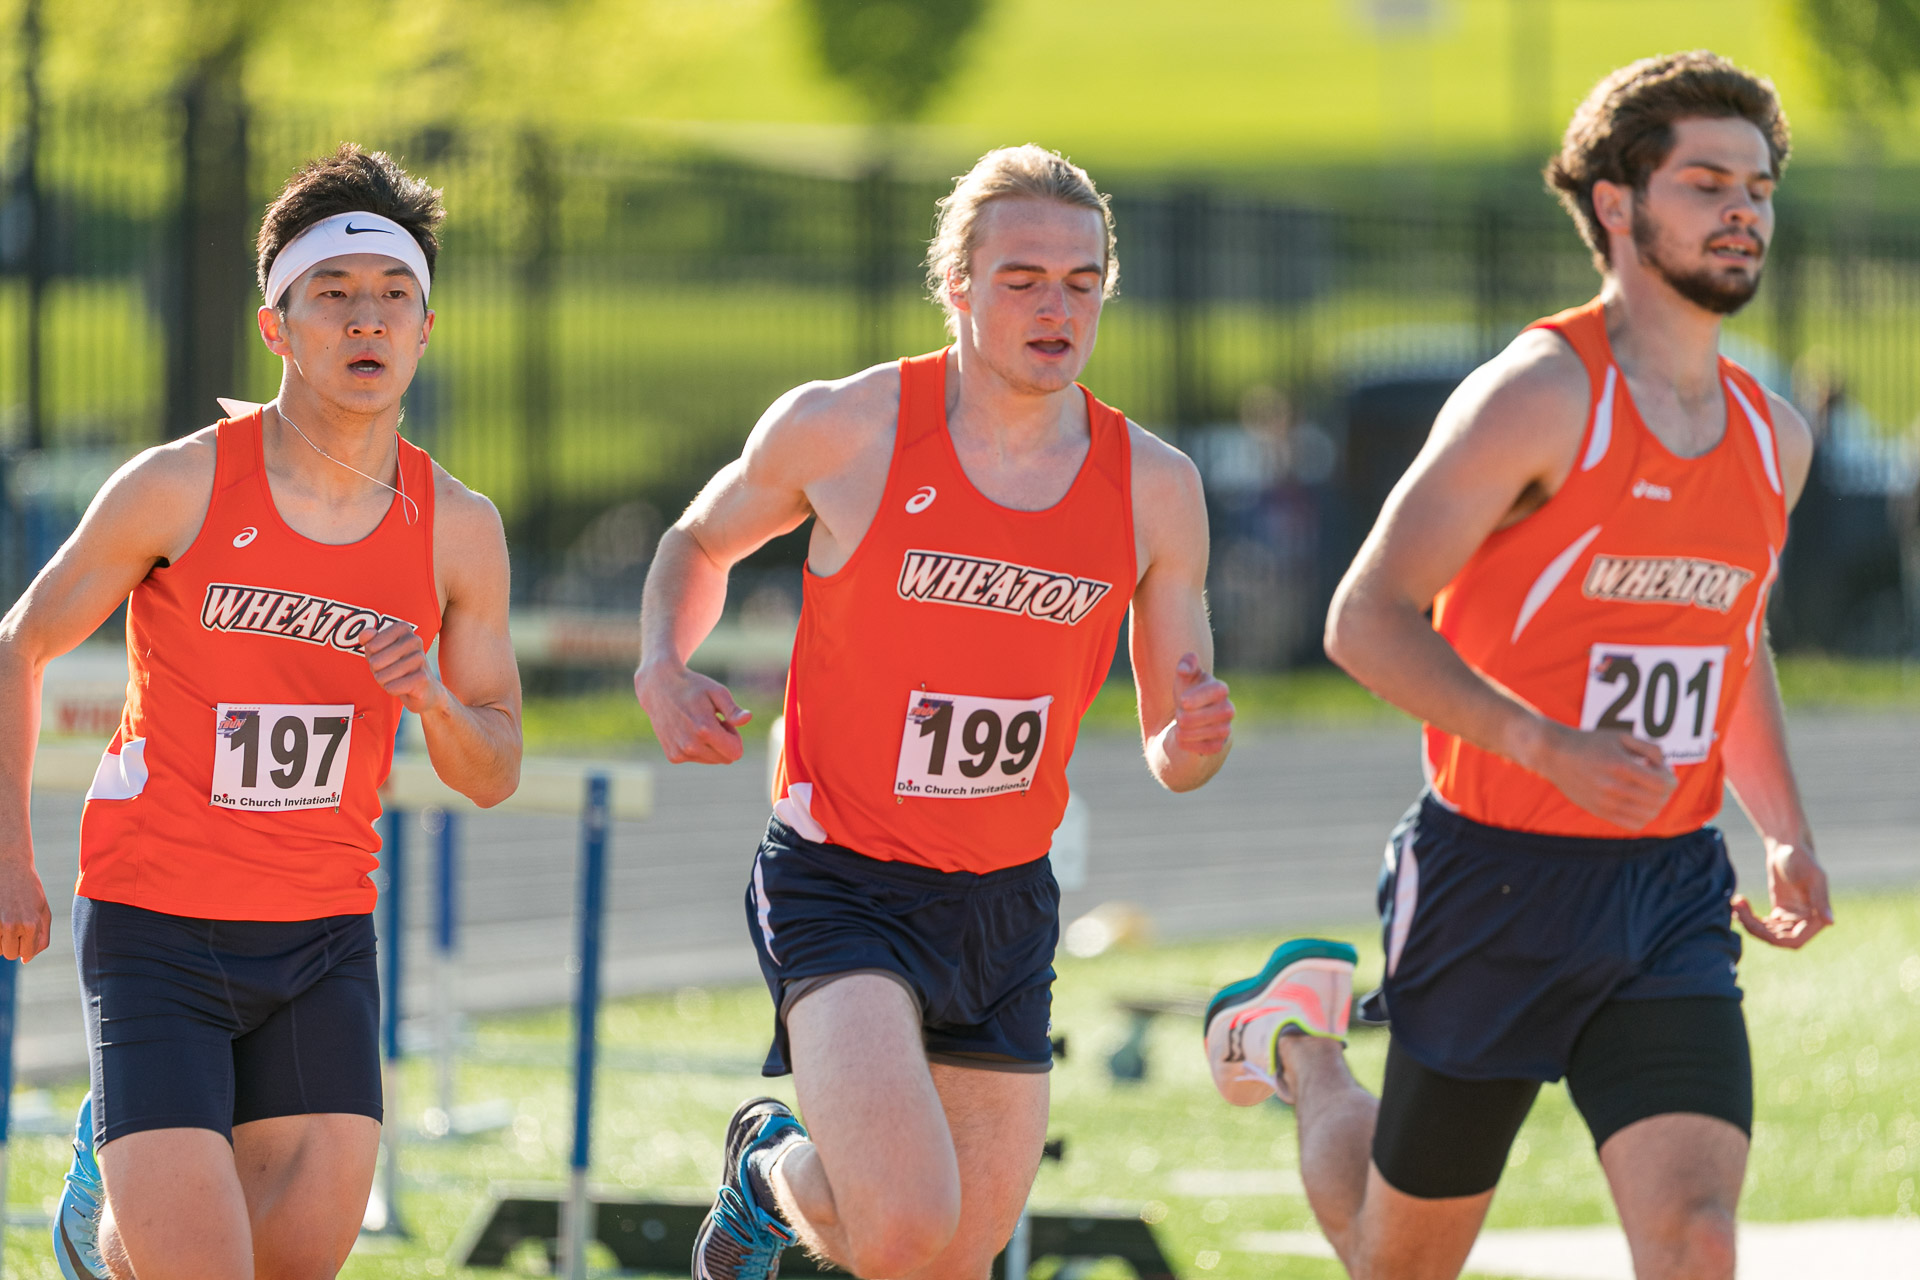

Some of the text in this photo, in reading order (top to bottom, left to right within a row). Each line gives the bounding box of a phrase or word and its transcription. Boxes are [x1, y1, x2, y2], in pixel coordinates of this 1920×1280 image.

[200, 583, 418, 658] WHEATO
[897, 549, 1112, 625] WHEATON
[1582, 554, 1755, 613] WHEATON
[1595, 657, 1711, 738] 201
[230, 714, 350, 790] 197
[918, 703, 1042, 778] 199
[213, 794, 340, 807] Don Church Invitational
[897, 779, 1029, 795] Don Church Invitational
